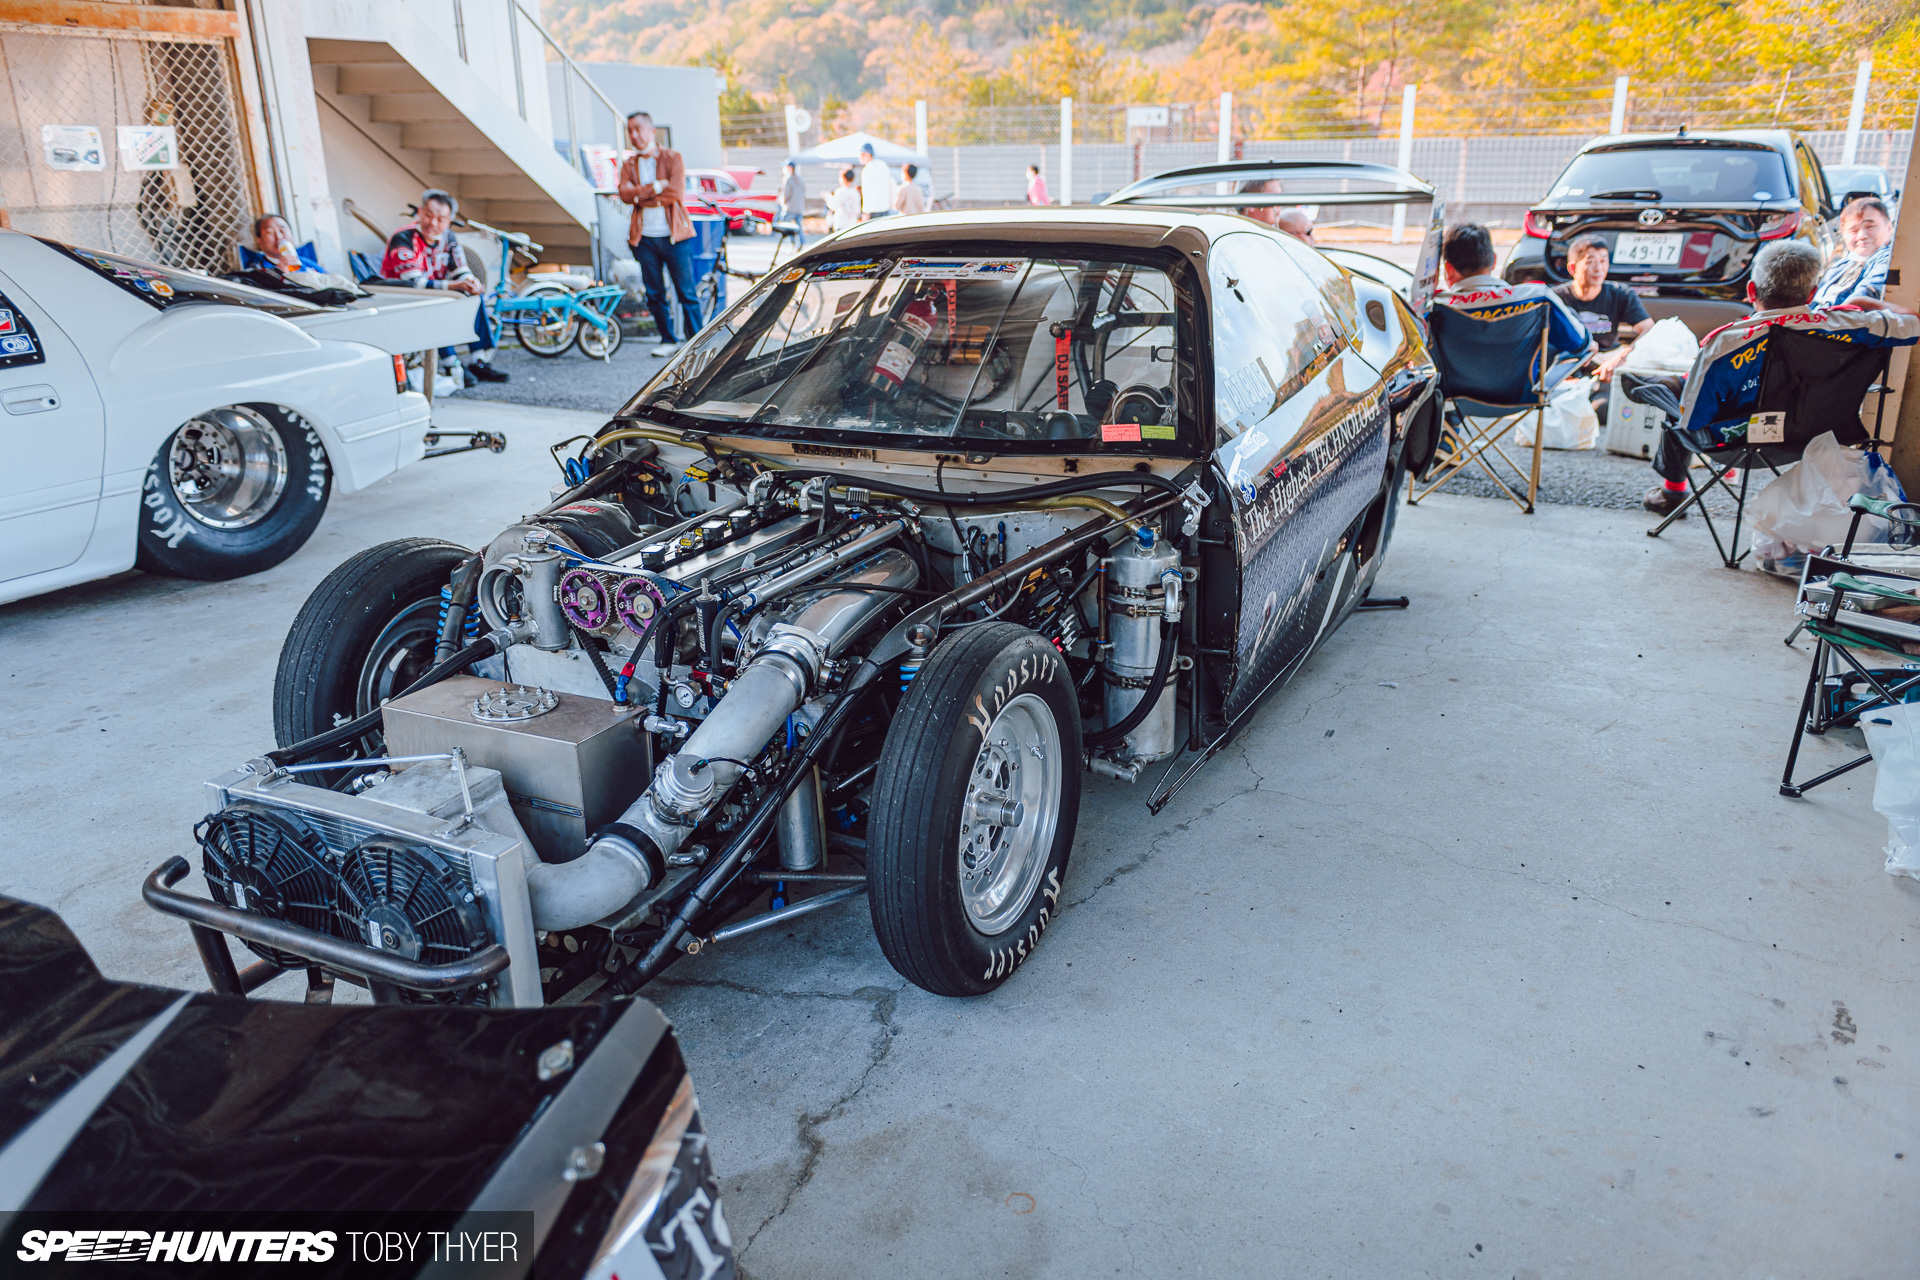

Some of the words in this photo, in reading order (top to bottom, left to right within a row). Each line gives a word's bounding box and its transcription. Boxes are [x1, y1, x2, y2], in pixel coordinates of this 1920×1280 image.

[1629, 246, 1676, 260] 49-17
[1448, 287, 1515, 307] JAPAN
[1057, 354, 1069, 371] DJ
[1244, 503, 1270, 542] The
[1270, 461, 1313, 519] Highest
[1312, 390, 1381, 475] TECHNOLOGY
